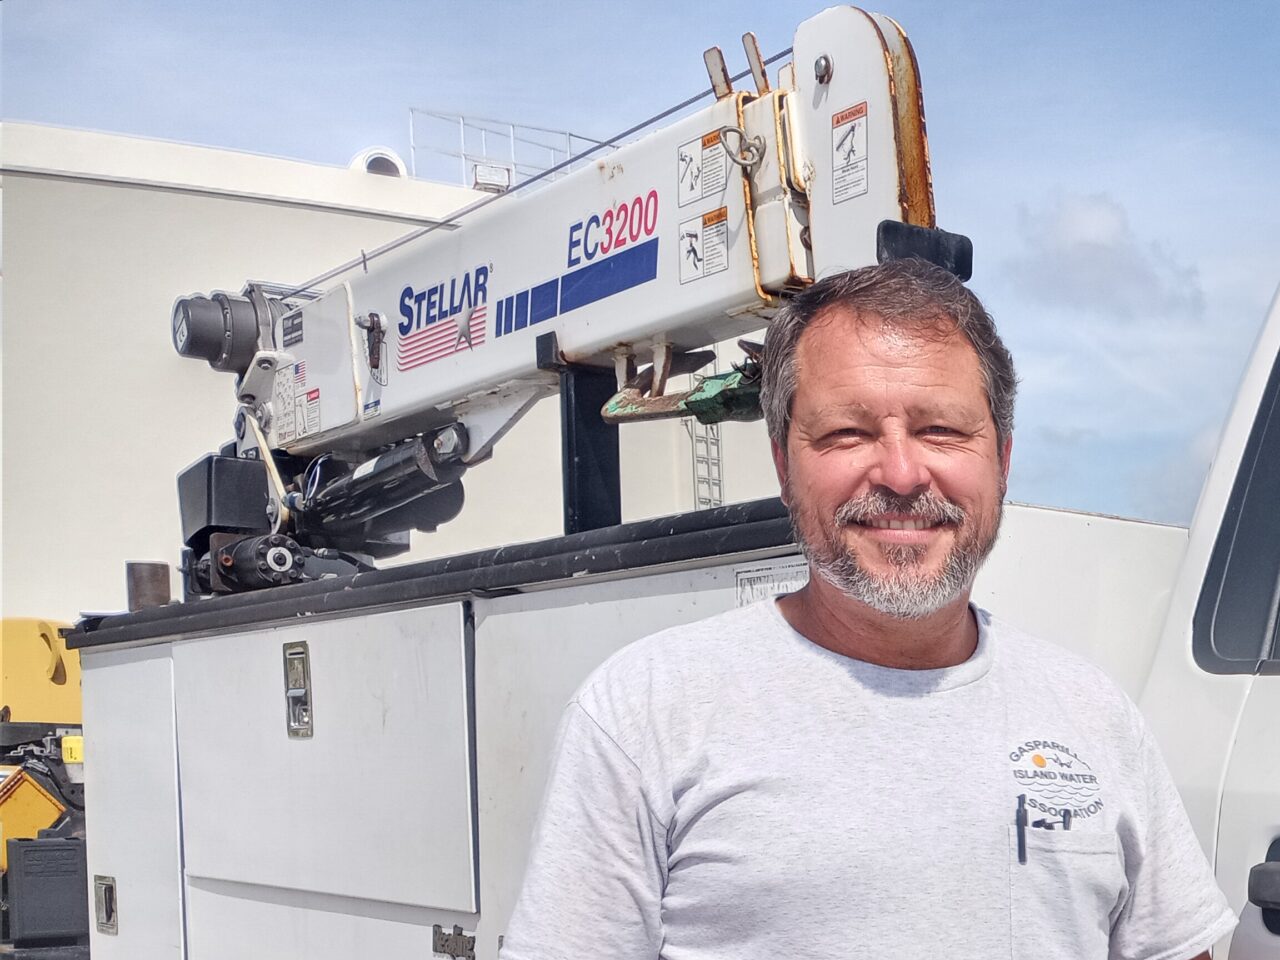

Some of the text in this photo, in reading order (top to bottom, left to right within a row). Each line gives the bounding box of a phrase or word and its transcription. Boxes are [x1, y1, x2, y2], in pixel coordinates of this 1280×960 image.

[567, 189, 659, 269] EC3200
[398, 265, 489, 336] STELLAR
[1013, 769, 1099, 784] ISLAND WATER
[1027, 798, 1104, 819] SSOCATION
